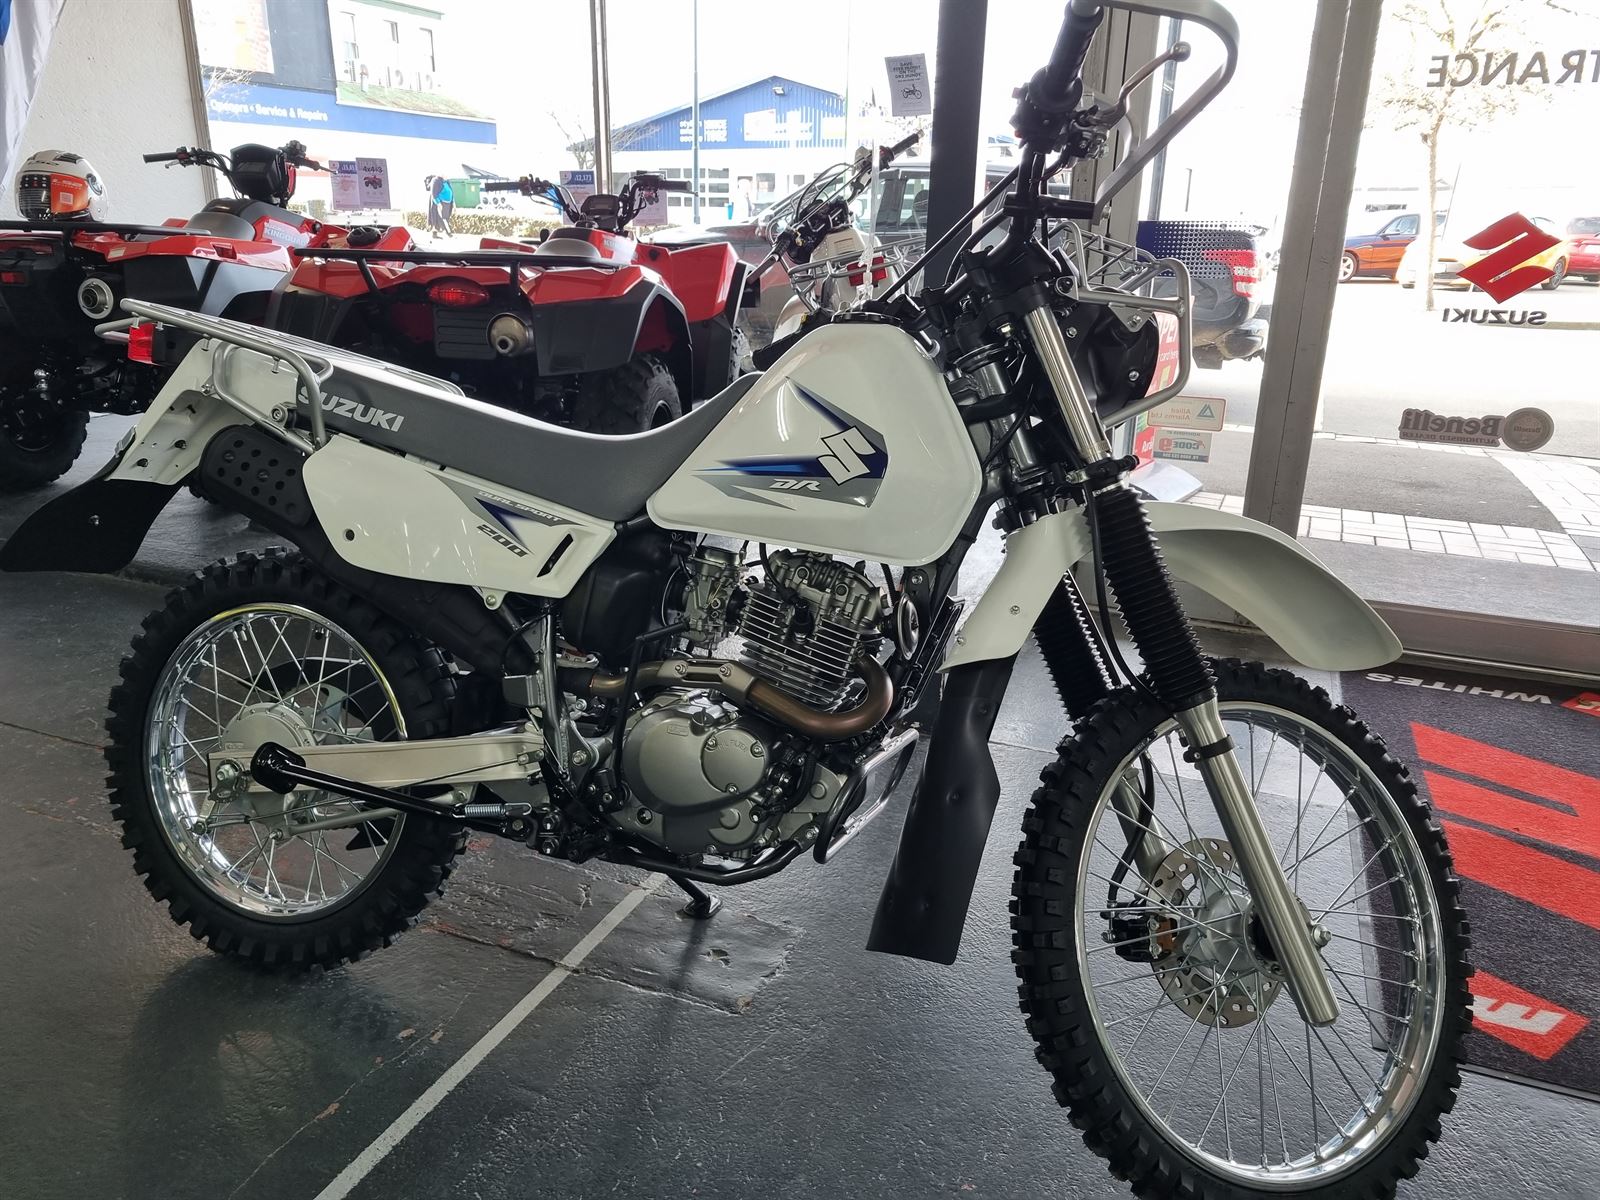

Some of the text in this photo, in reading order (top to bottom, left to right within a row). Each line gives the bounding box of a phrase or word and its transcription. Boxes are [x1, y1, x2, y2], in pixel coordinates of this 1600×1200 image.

[255, 104, 288, 117] Service
[289, 107, 297, 118] &
[297, 108, 328, 122] Repairs
[769, 478, 821, 492] DR
[478, 490, 562, 522] DUAL SPORT
[476, 524, 528, 557] 200
[1365, 672, 1552, 705] WHITES
